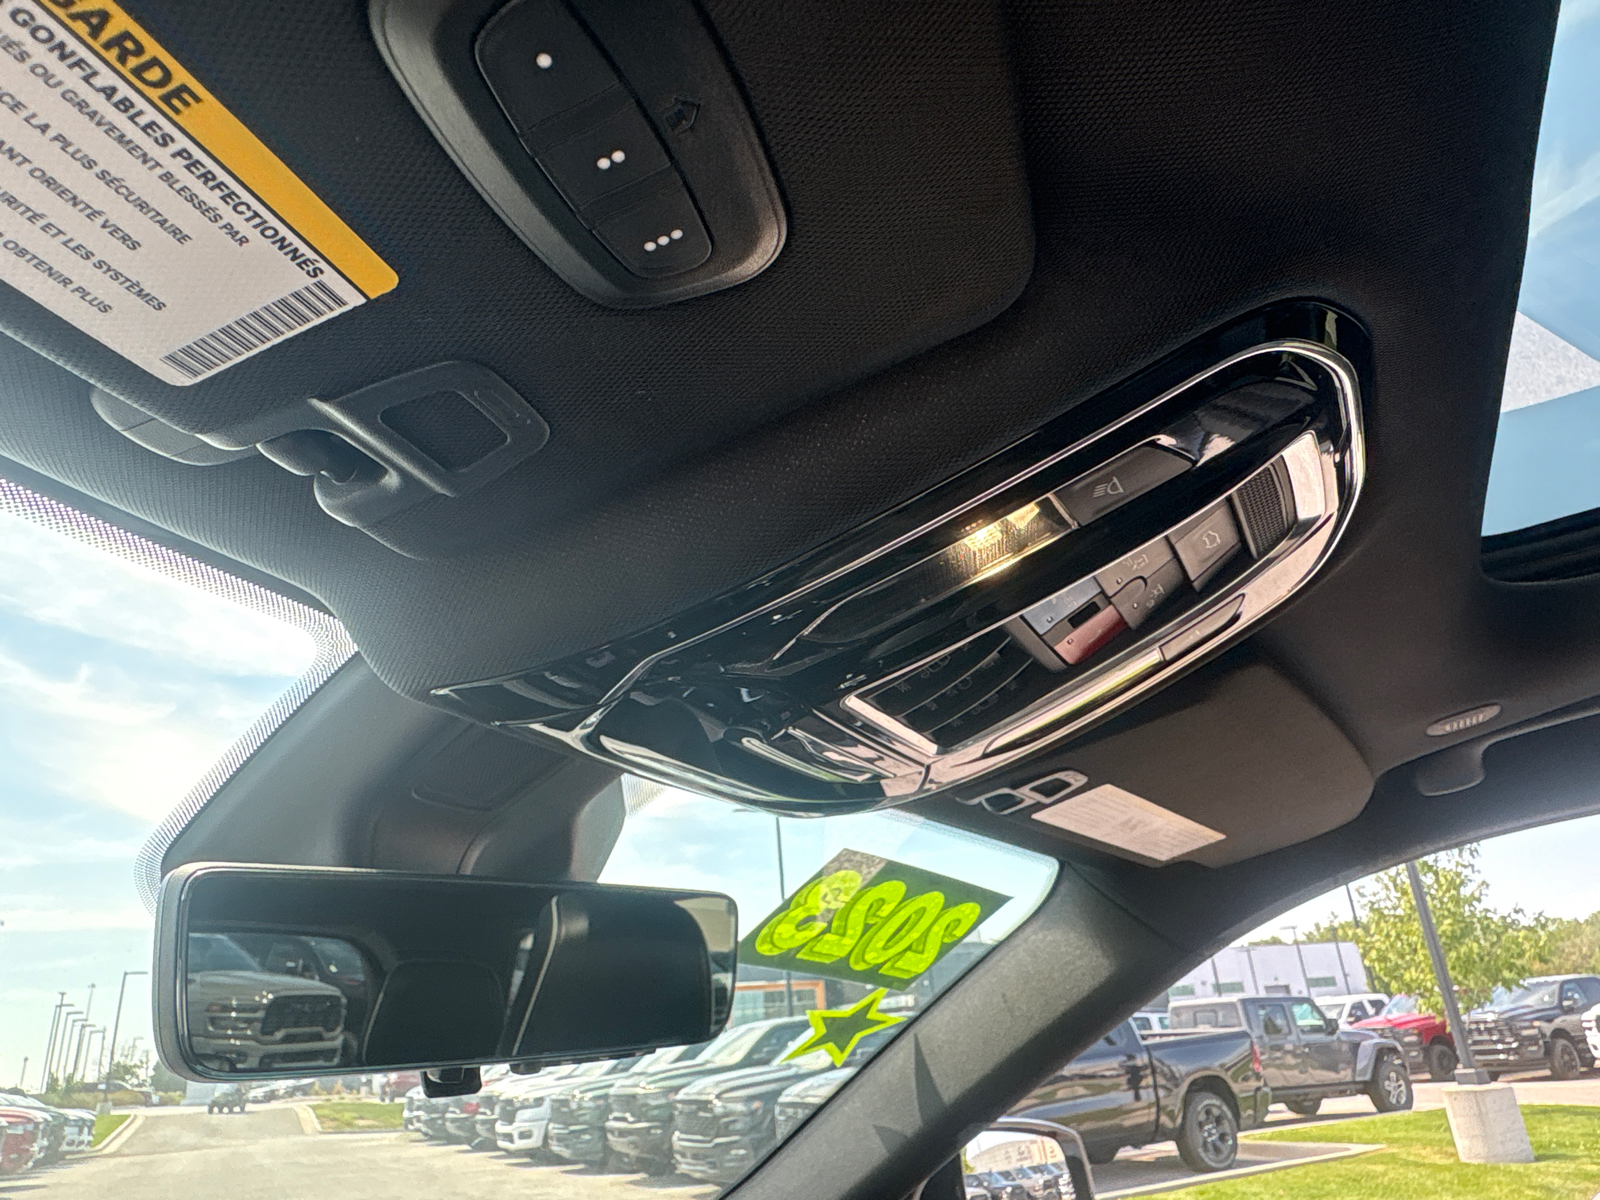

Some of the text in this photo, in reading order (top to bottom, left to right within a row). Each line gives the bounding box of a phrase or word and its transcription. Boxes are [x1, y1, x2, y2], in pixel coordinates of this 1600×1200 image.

[48, 0, 203, 115] ARDE
[0, 35, 249, 247] ÉS OU GRAVEMENT BLESSÉS PAR
[0, 91, 193, 245] CE LA PLUS SÉCURITAIRE
[10, 8, 324, 278] GONFLABLES PERFECTIONNÉS
[29, 167, 106, 222] ORIENTÉ
[100, 218, 142, 250] VERS
[2, 239, 112, 313] OBTENIR PLUS
[40, 222, 67, 238] ET
[61, 237, 95, 261] LES
[92, 259, 167, 311] SYSTÈMES
